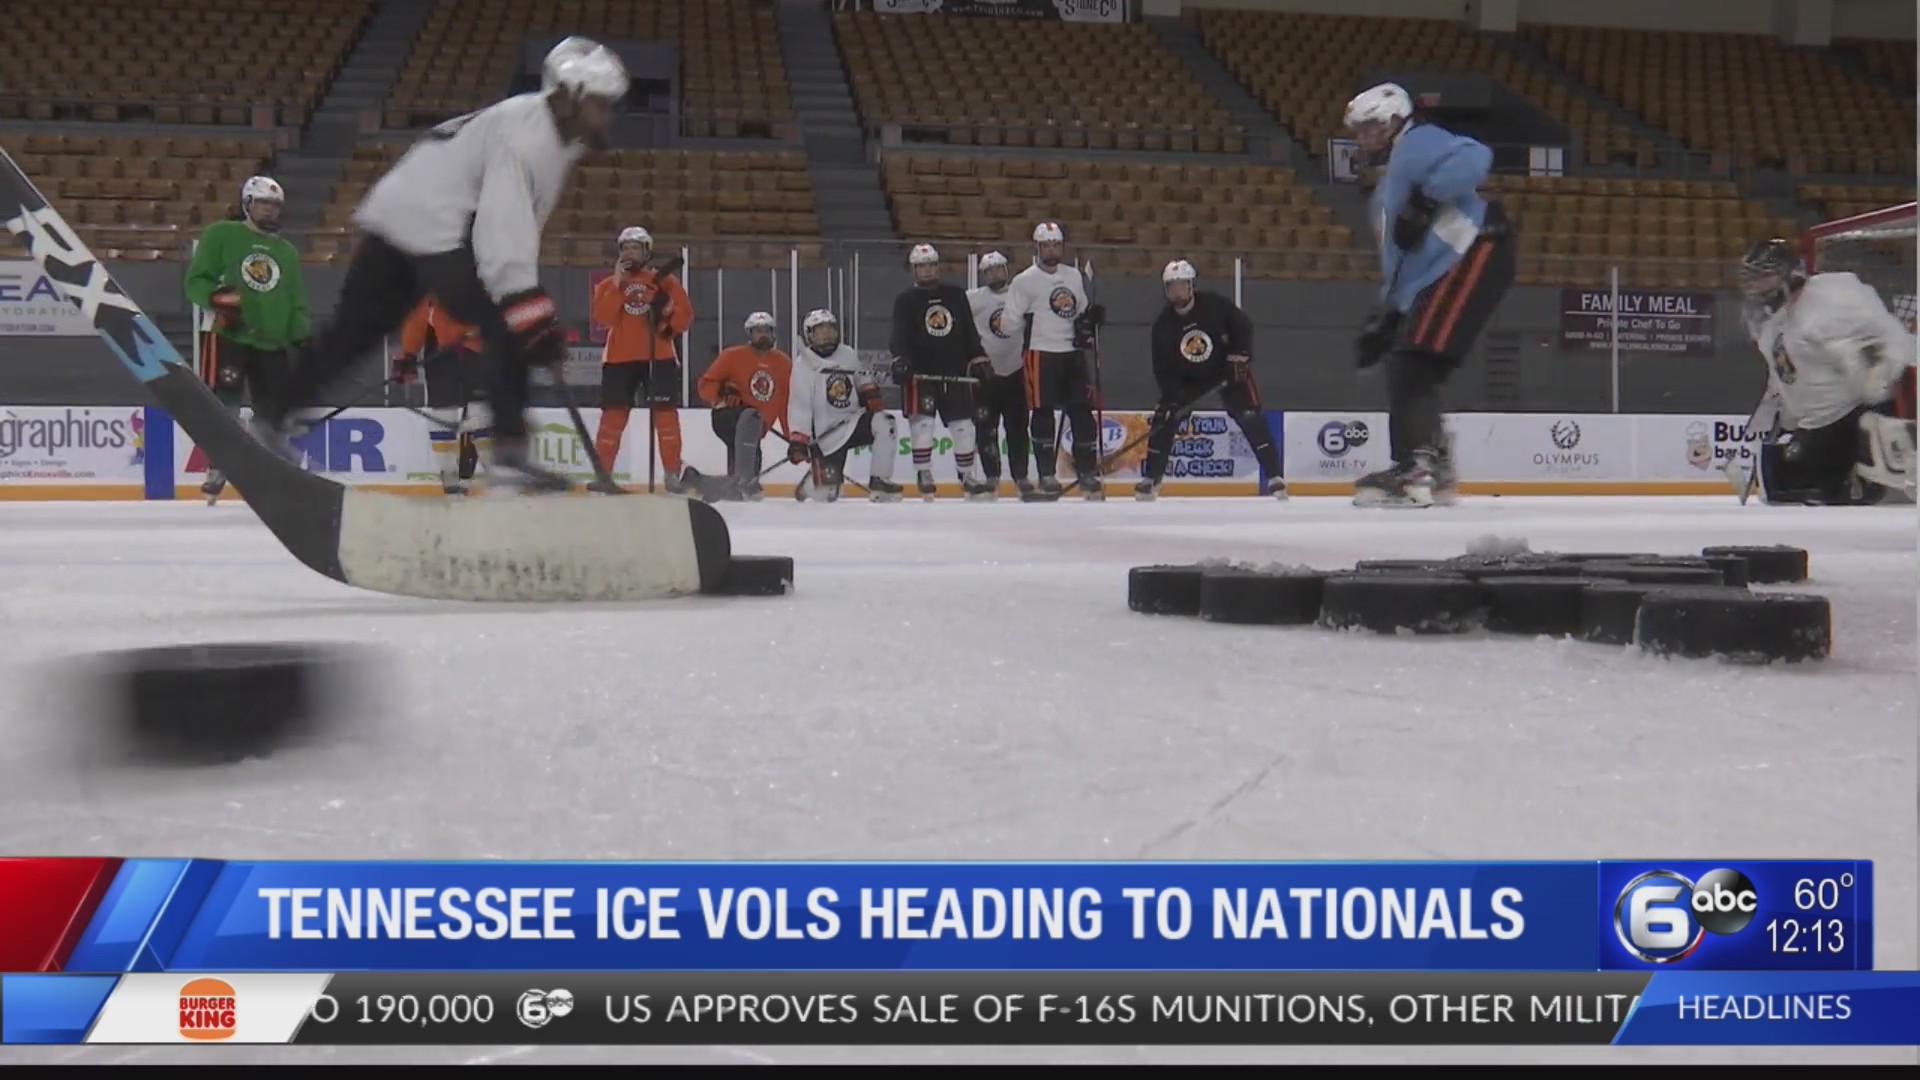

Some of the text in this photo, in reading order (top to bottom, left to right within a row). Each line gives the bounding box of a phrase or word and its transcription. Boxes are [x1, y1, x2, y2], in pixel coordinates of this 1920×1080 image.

[1648, 295, 1697, 313] MEAL
[1631, 319, 1652, 329] Chef
[1655, 320, 1666, 329] To
[1668, 320, 1681, 330] Go
[1324, 426, 1369, 451] 6 abc
[1533, 453, 1599, 465] OLYMPUS
